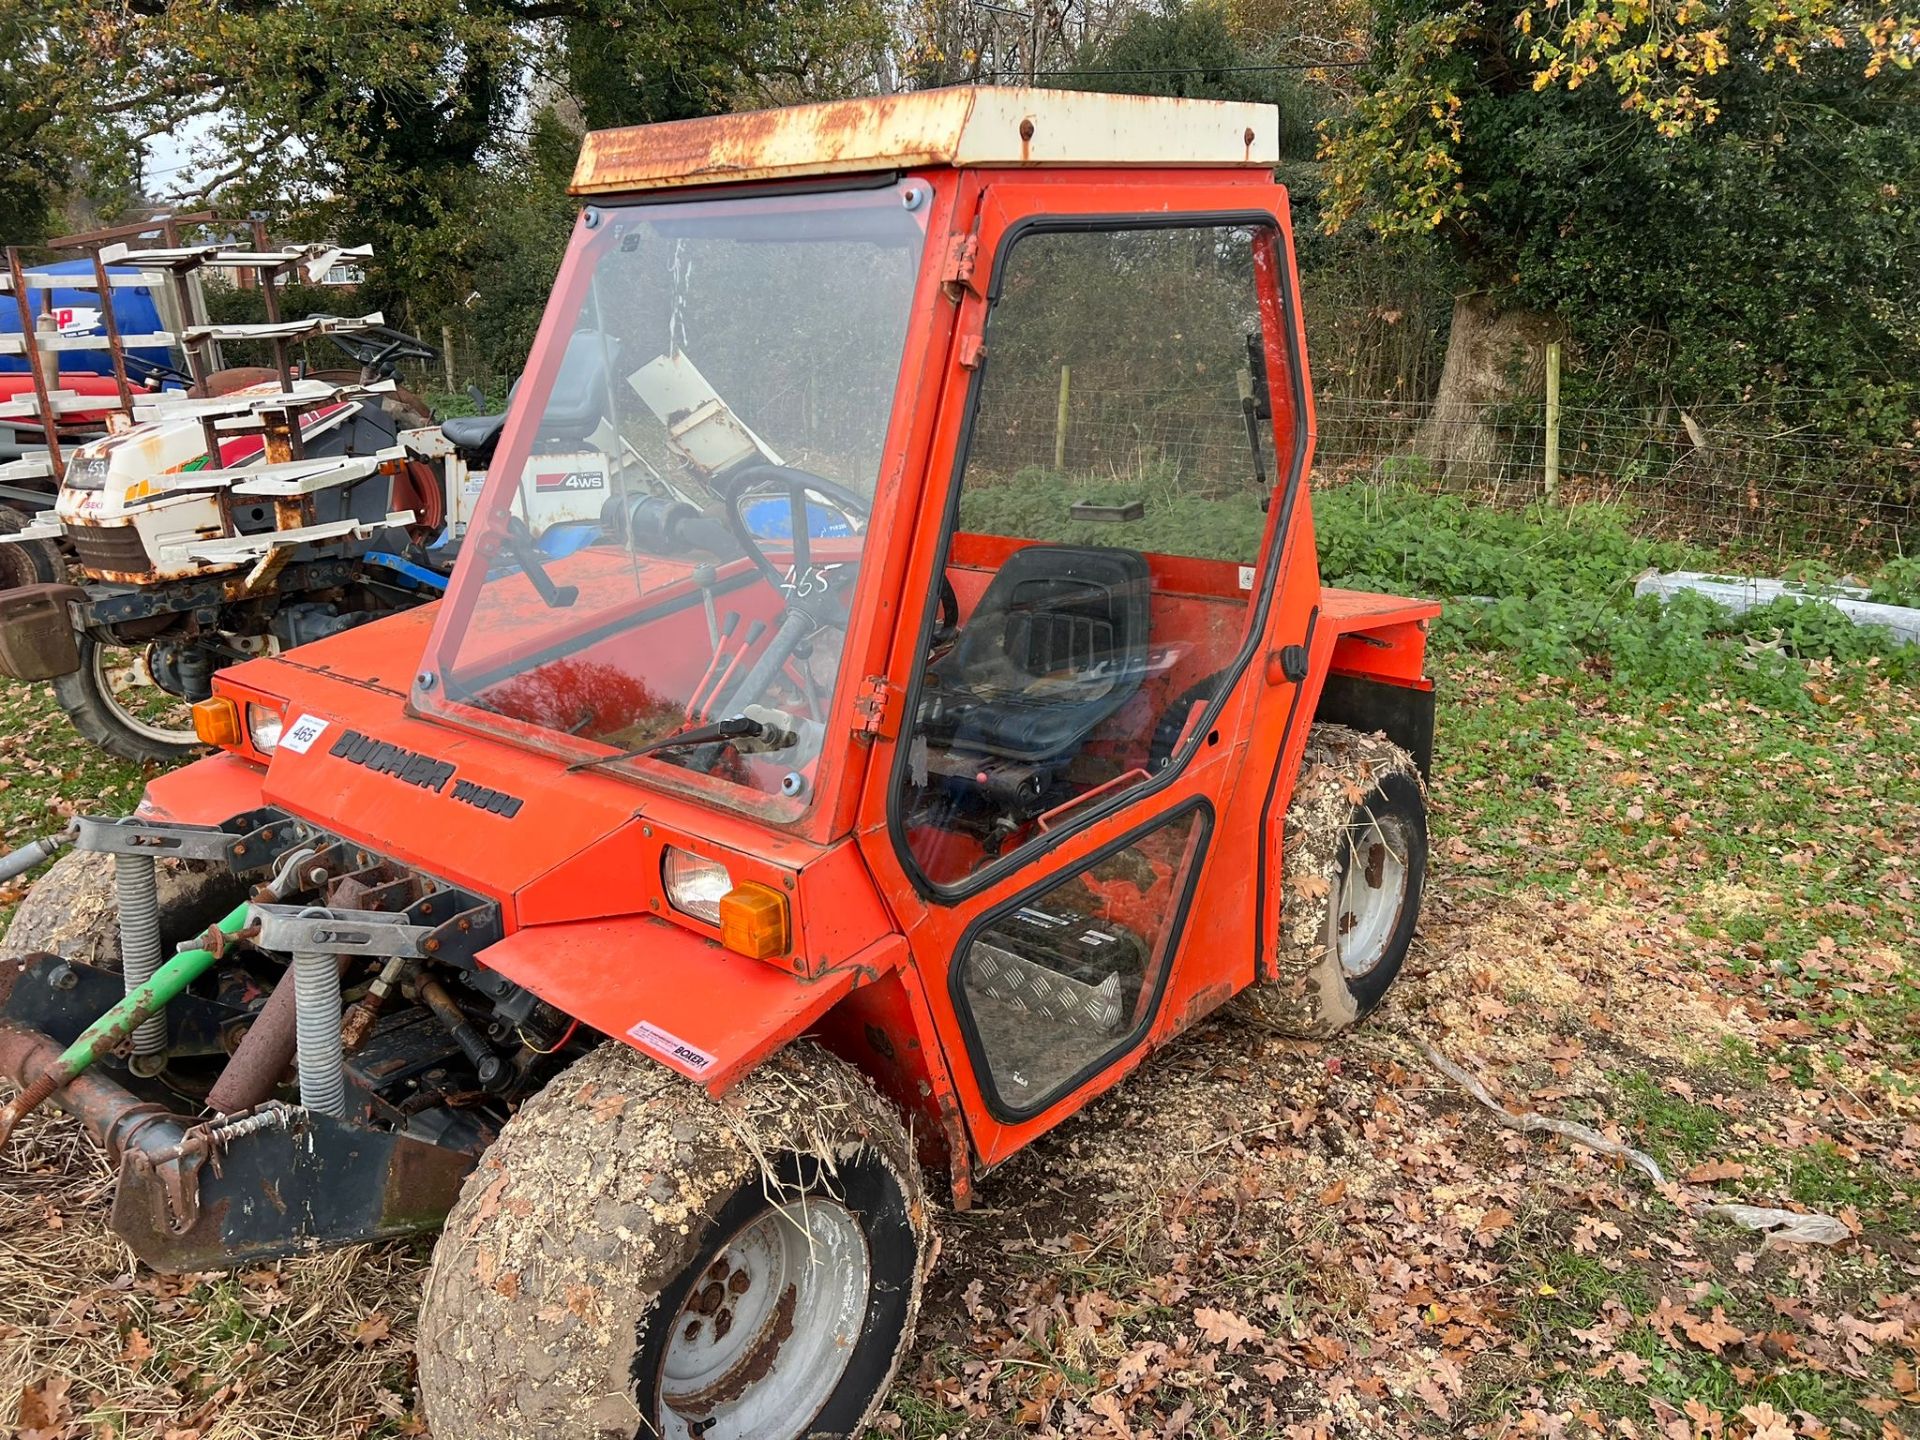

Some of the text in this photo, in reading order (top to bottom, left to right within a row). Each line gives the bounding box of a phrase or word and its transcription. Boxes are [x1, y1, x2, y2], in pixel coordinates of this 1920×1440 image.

[565, 475, 602, 488] 4WS
[780, 563, 843, 600] 465
[293, 725, 317, 742] 465
[329, 729, 456, 793] BUCHER
